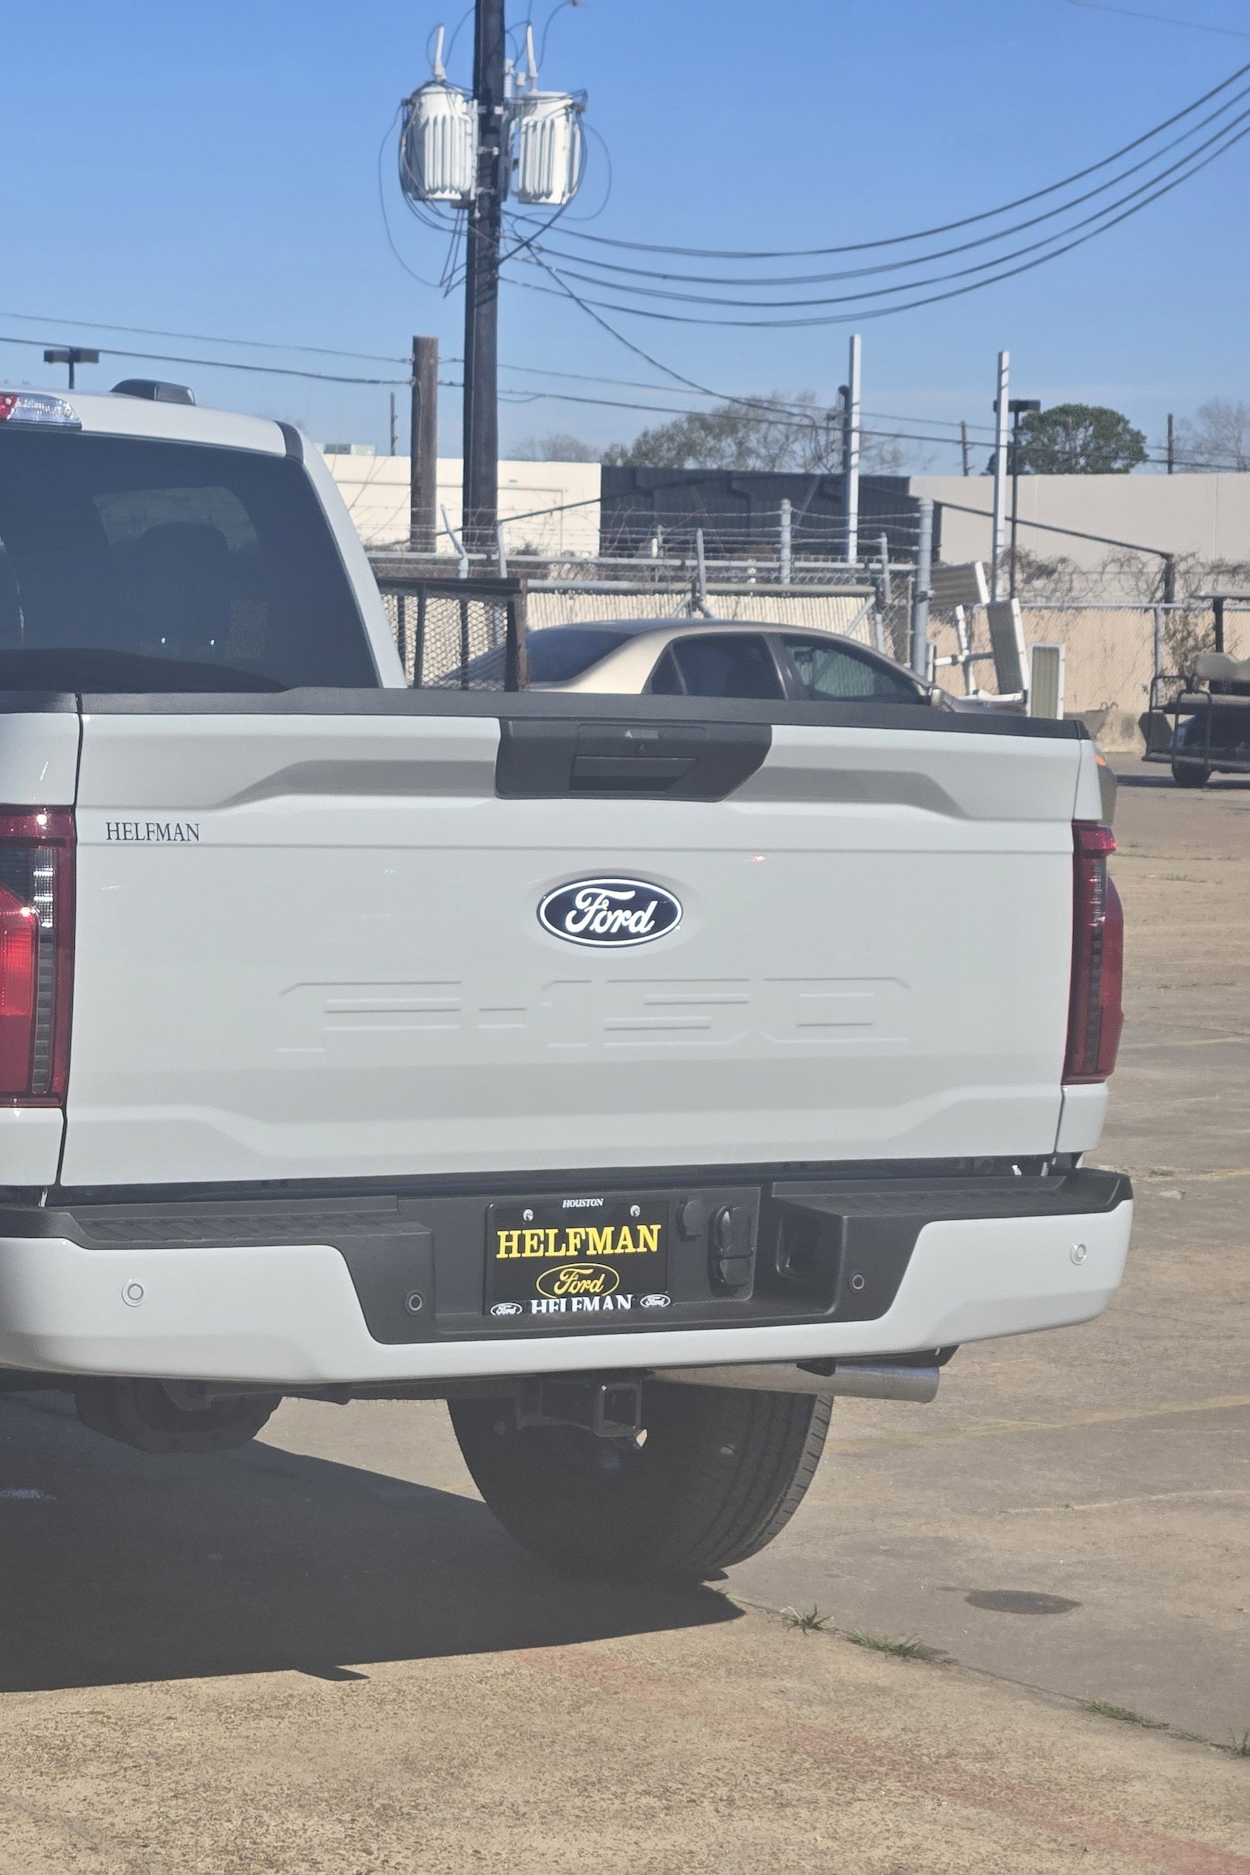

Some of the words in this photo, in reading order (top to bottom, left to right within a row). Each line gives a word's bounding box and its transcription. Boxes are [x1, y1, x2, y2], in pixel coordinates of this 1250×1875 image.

[105, 821, 200, 842] HELFMAN
[565, 887, 658, 933] Ford
[562, 1198, 604, 1209] HOUSTON
[496, 1224, 662, 1259] HELFMAN
[553, 1268, 606, 1295] Ford
[531, 1294, 633, 1315] HELFMAN
